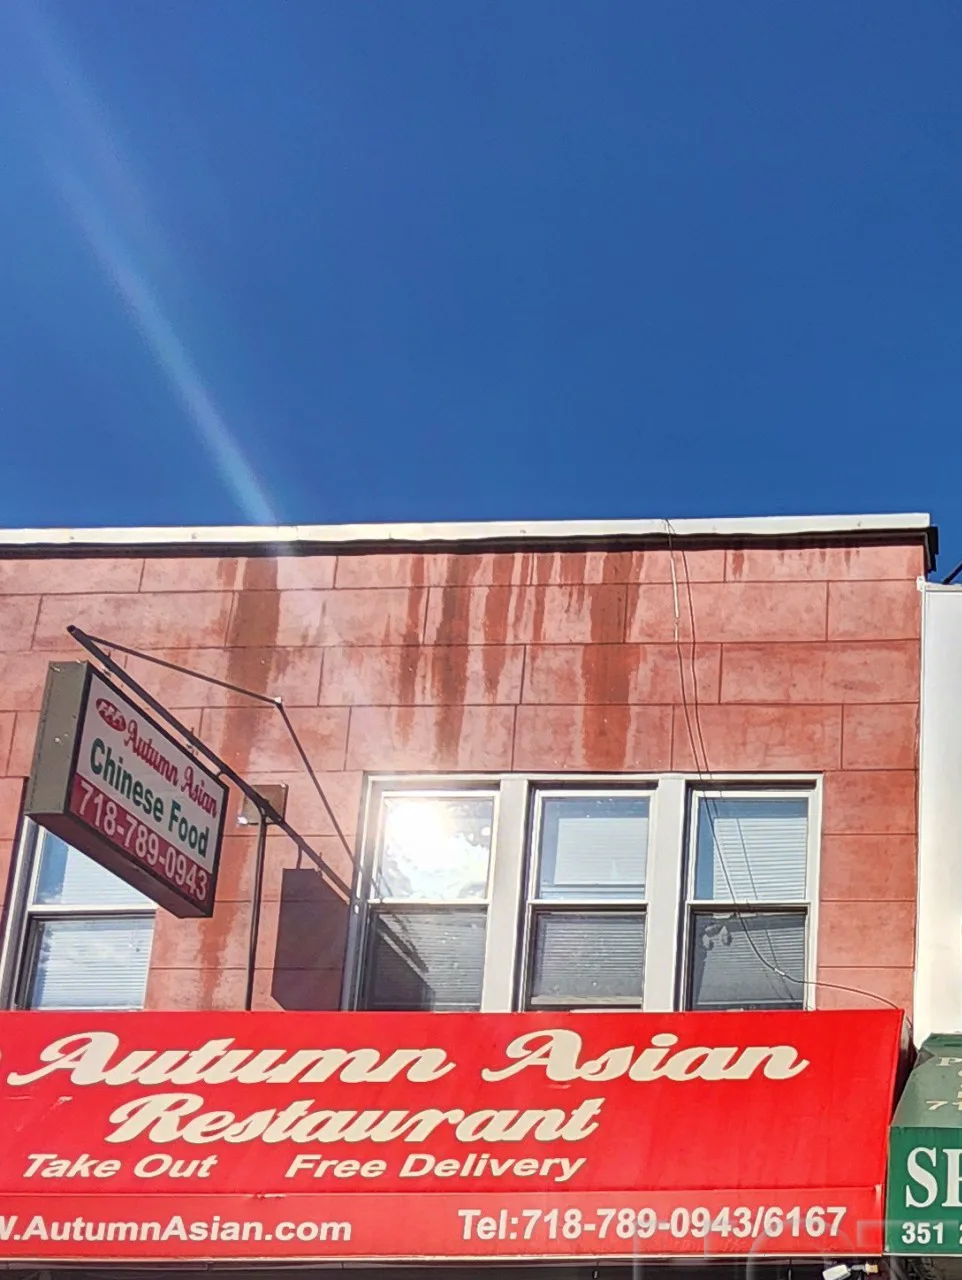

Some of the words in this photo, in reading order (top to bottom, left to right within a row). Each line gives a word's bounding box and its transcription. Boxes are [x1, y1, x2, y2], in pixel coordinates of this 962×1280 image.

[124, 719, 179, 786] Autumn
[181, 766, 217, 818] Asian
[90, 738, 164, 822] Chinese
[168, 800, 209, 858] Food
[80, 780, 208, 901] 718-789-0943
[7, 1031, 456, 1086] Autumn
[481, 1028, 810, 1082] Asian
[105, 1092, 606, 1145] Restaurant
[22, 1153, 118, 1178] Take
[134, 1153, 218, 1178] Out
[285, 1153, 388, 1178] Free
[398, 1152, 587, 1182] Delivery
[458, 1205, 847, 1240] Tel:718-789-0943/6167
[901, 1222, 944, 1245] 351
